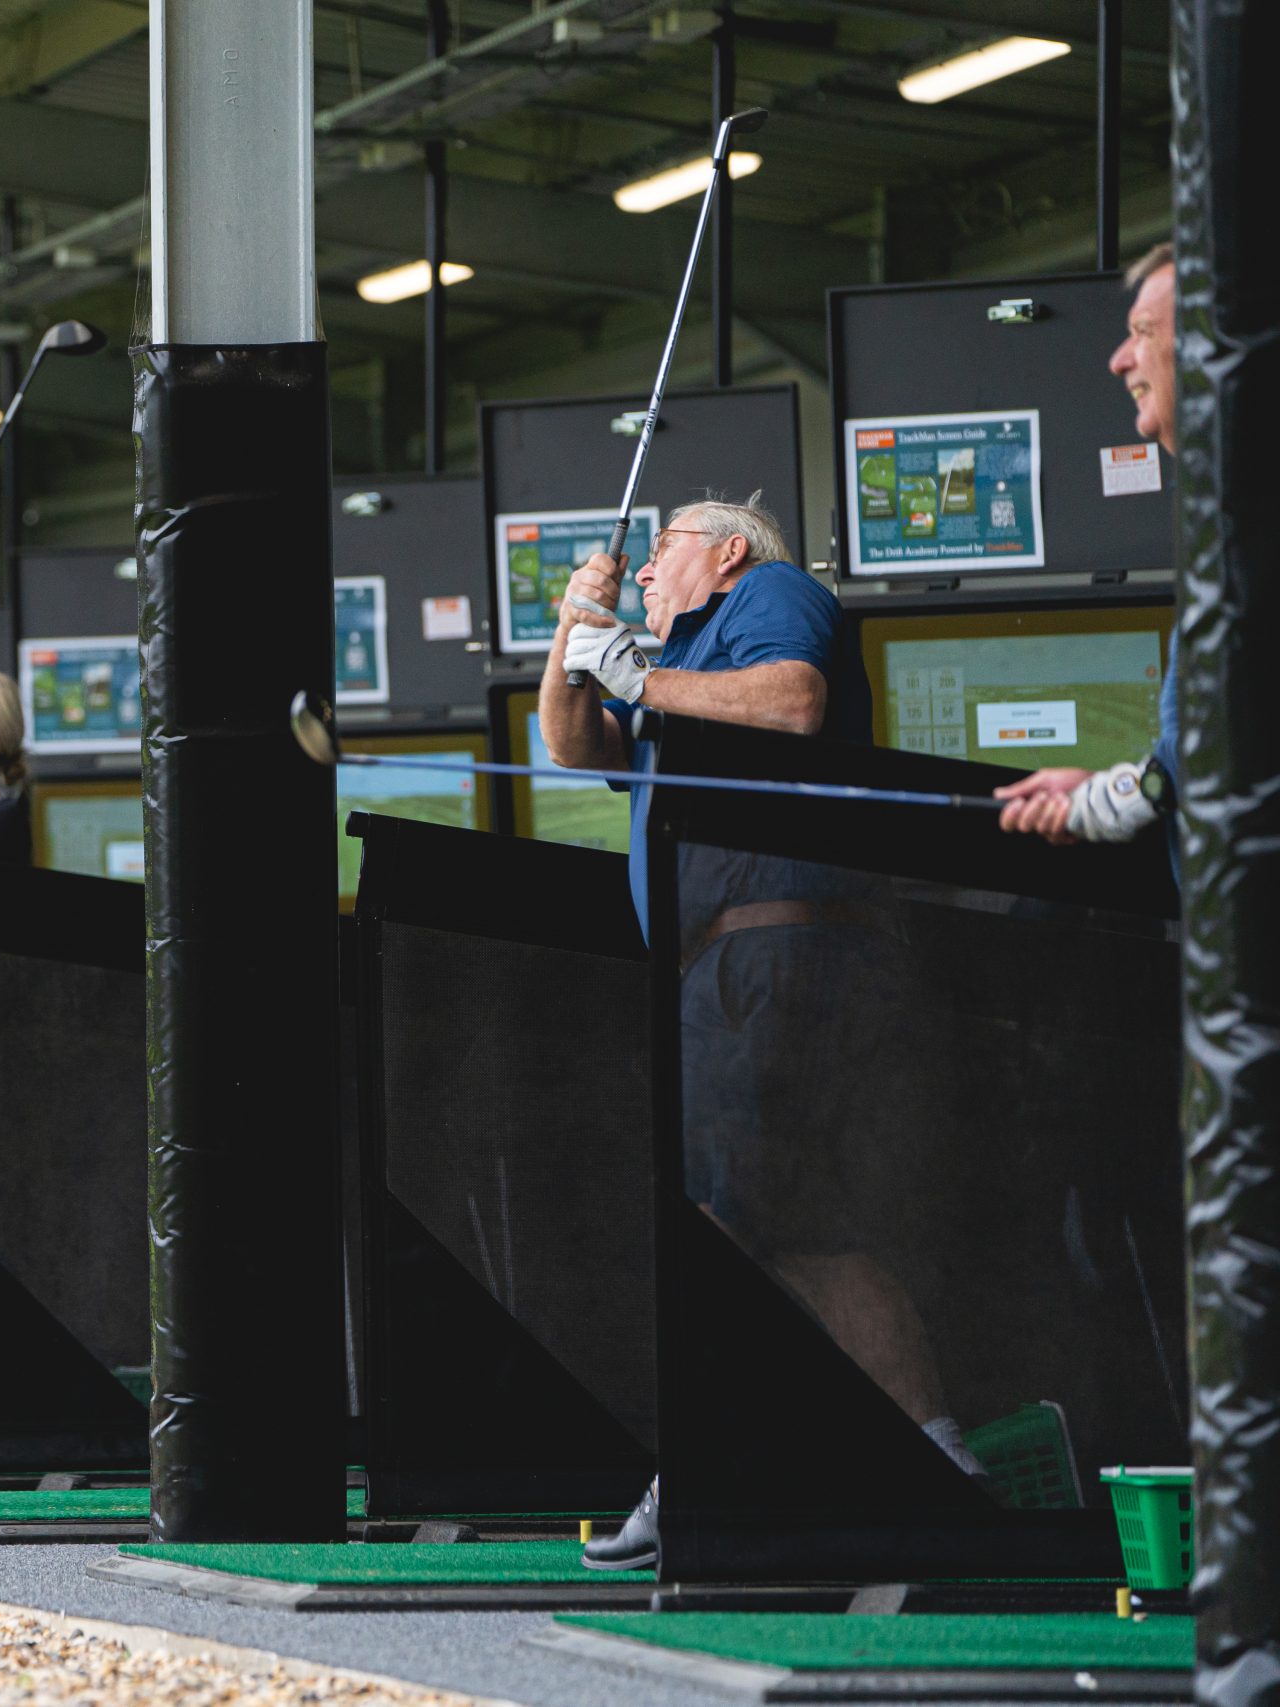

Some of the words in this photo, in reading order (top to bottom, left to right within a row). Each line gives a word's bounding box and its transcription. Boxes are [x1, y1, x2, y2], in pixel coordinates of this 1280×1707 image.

[870, 547, 883, 558] The
[940, 543, 972, 554] Powered
[974, 542, 984, 554] by
